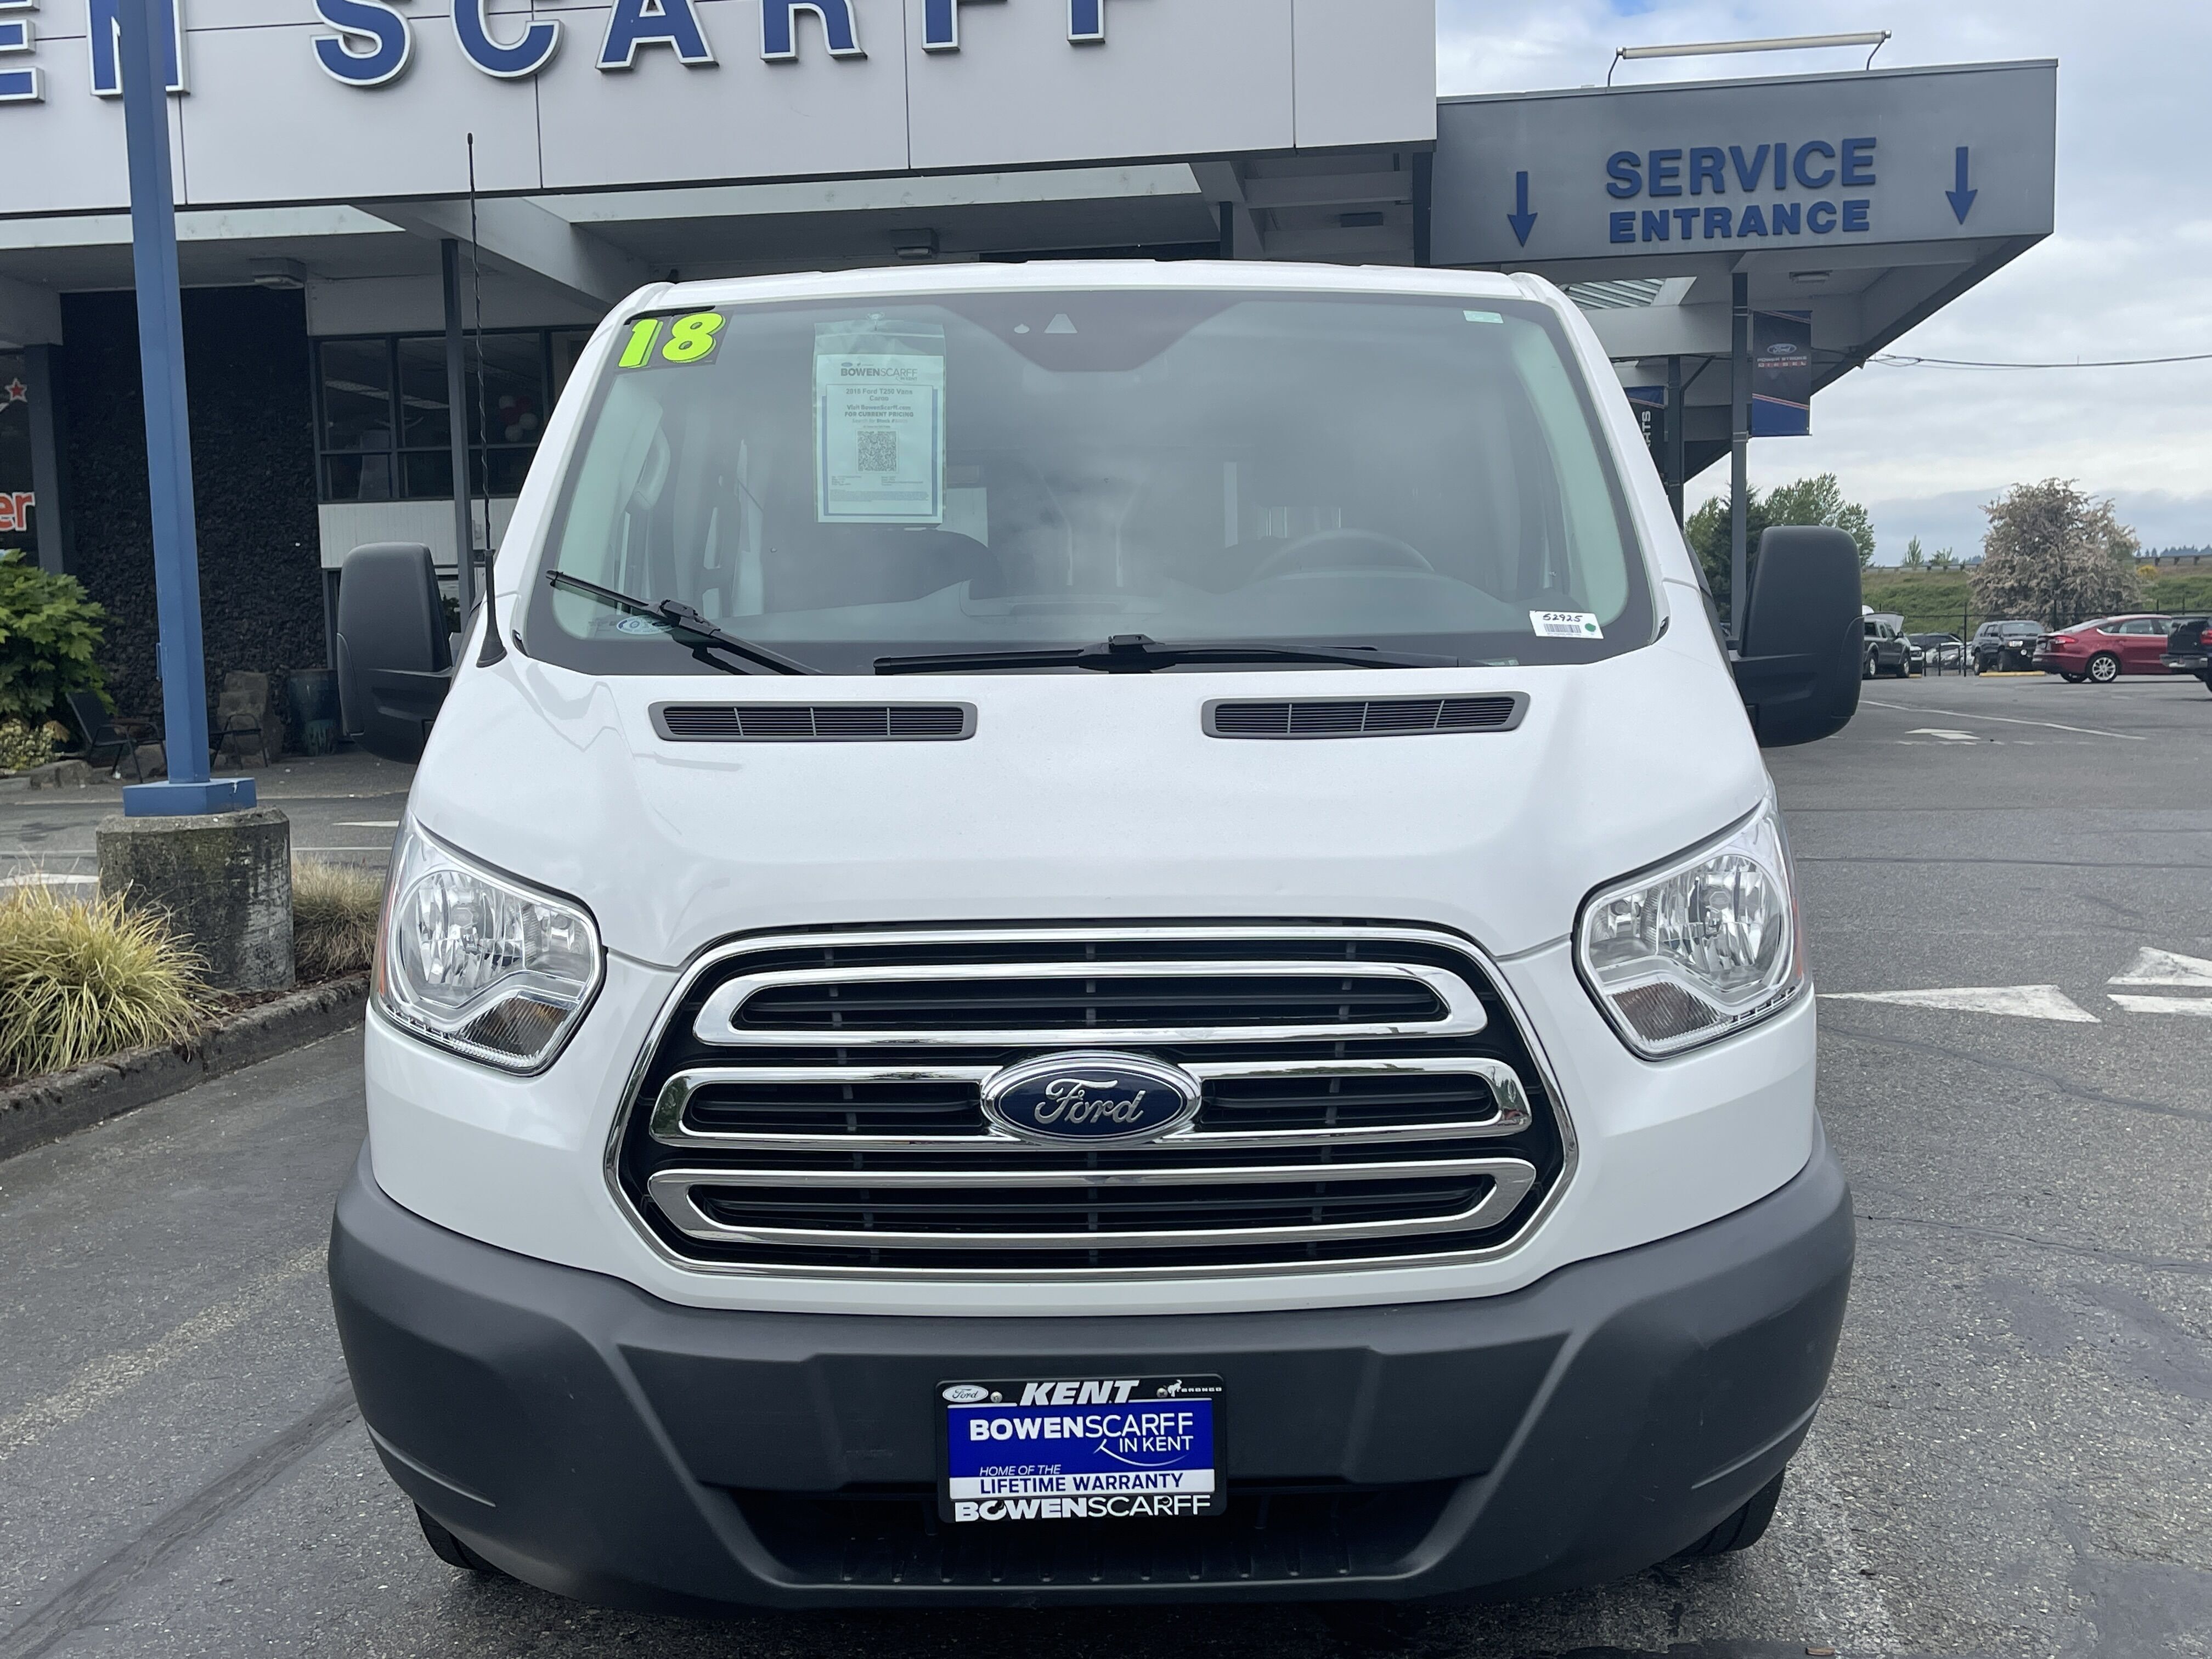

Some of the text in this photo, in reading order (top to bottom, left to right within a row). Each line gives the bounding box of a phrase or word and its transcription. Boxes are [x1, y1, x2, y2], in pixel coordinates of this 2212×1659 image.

[1606, 137, 1877, 198] SERVICE
[1610, 199, 1870, 244] ENTRANCE
[618, 312, 726, 369] 18
[840, 368, 918, 377] BOWENSCARFF
[1035, 1077, 1147, 1124] Ford
[952, 1389, 979, 1398] Ford
[1020, 1379, 1141, 1406] KENT
[969, 1412, 1193, 1441] BOWENSCARFF
[1119, 1436, 1193, 1453] IN KENT
[979, 1464, 1062, 1476] HOME OF THE
[980, 1472, 1184, 1494] LIFETIME WARRANTY
[955, 1495, 1211, 1522] BOWENSCARFF
